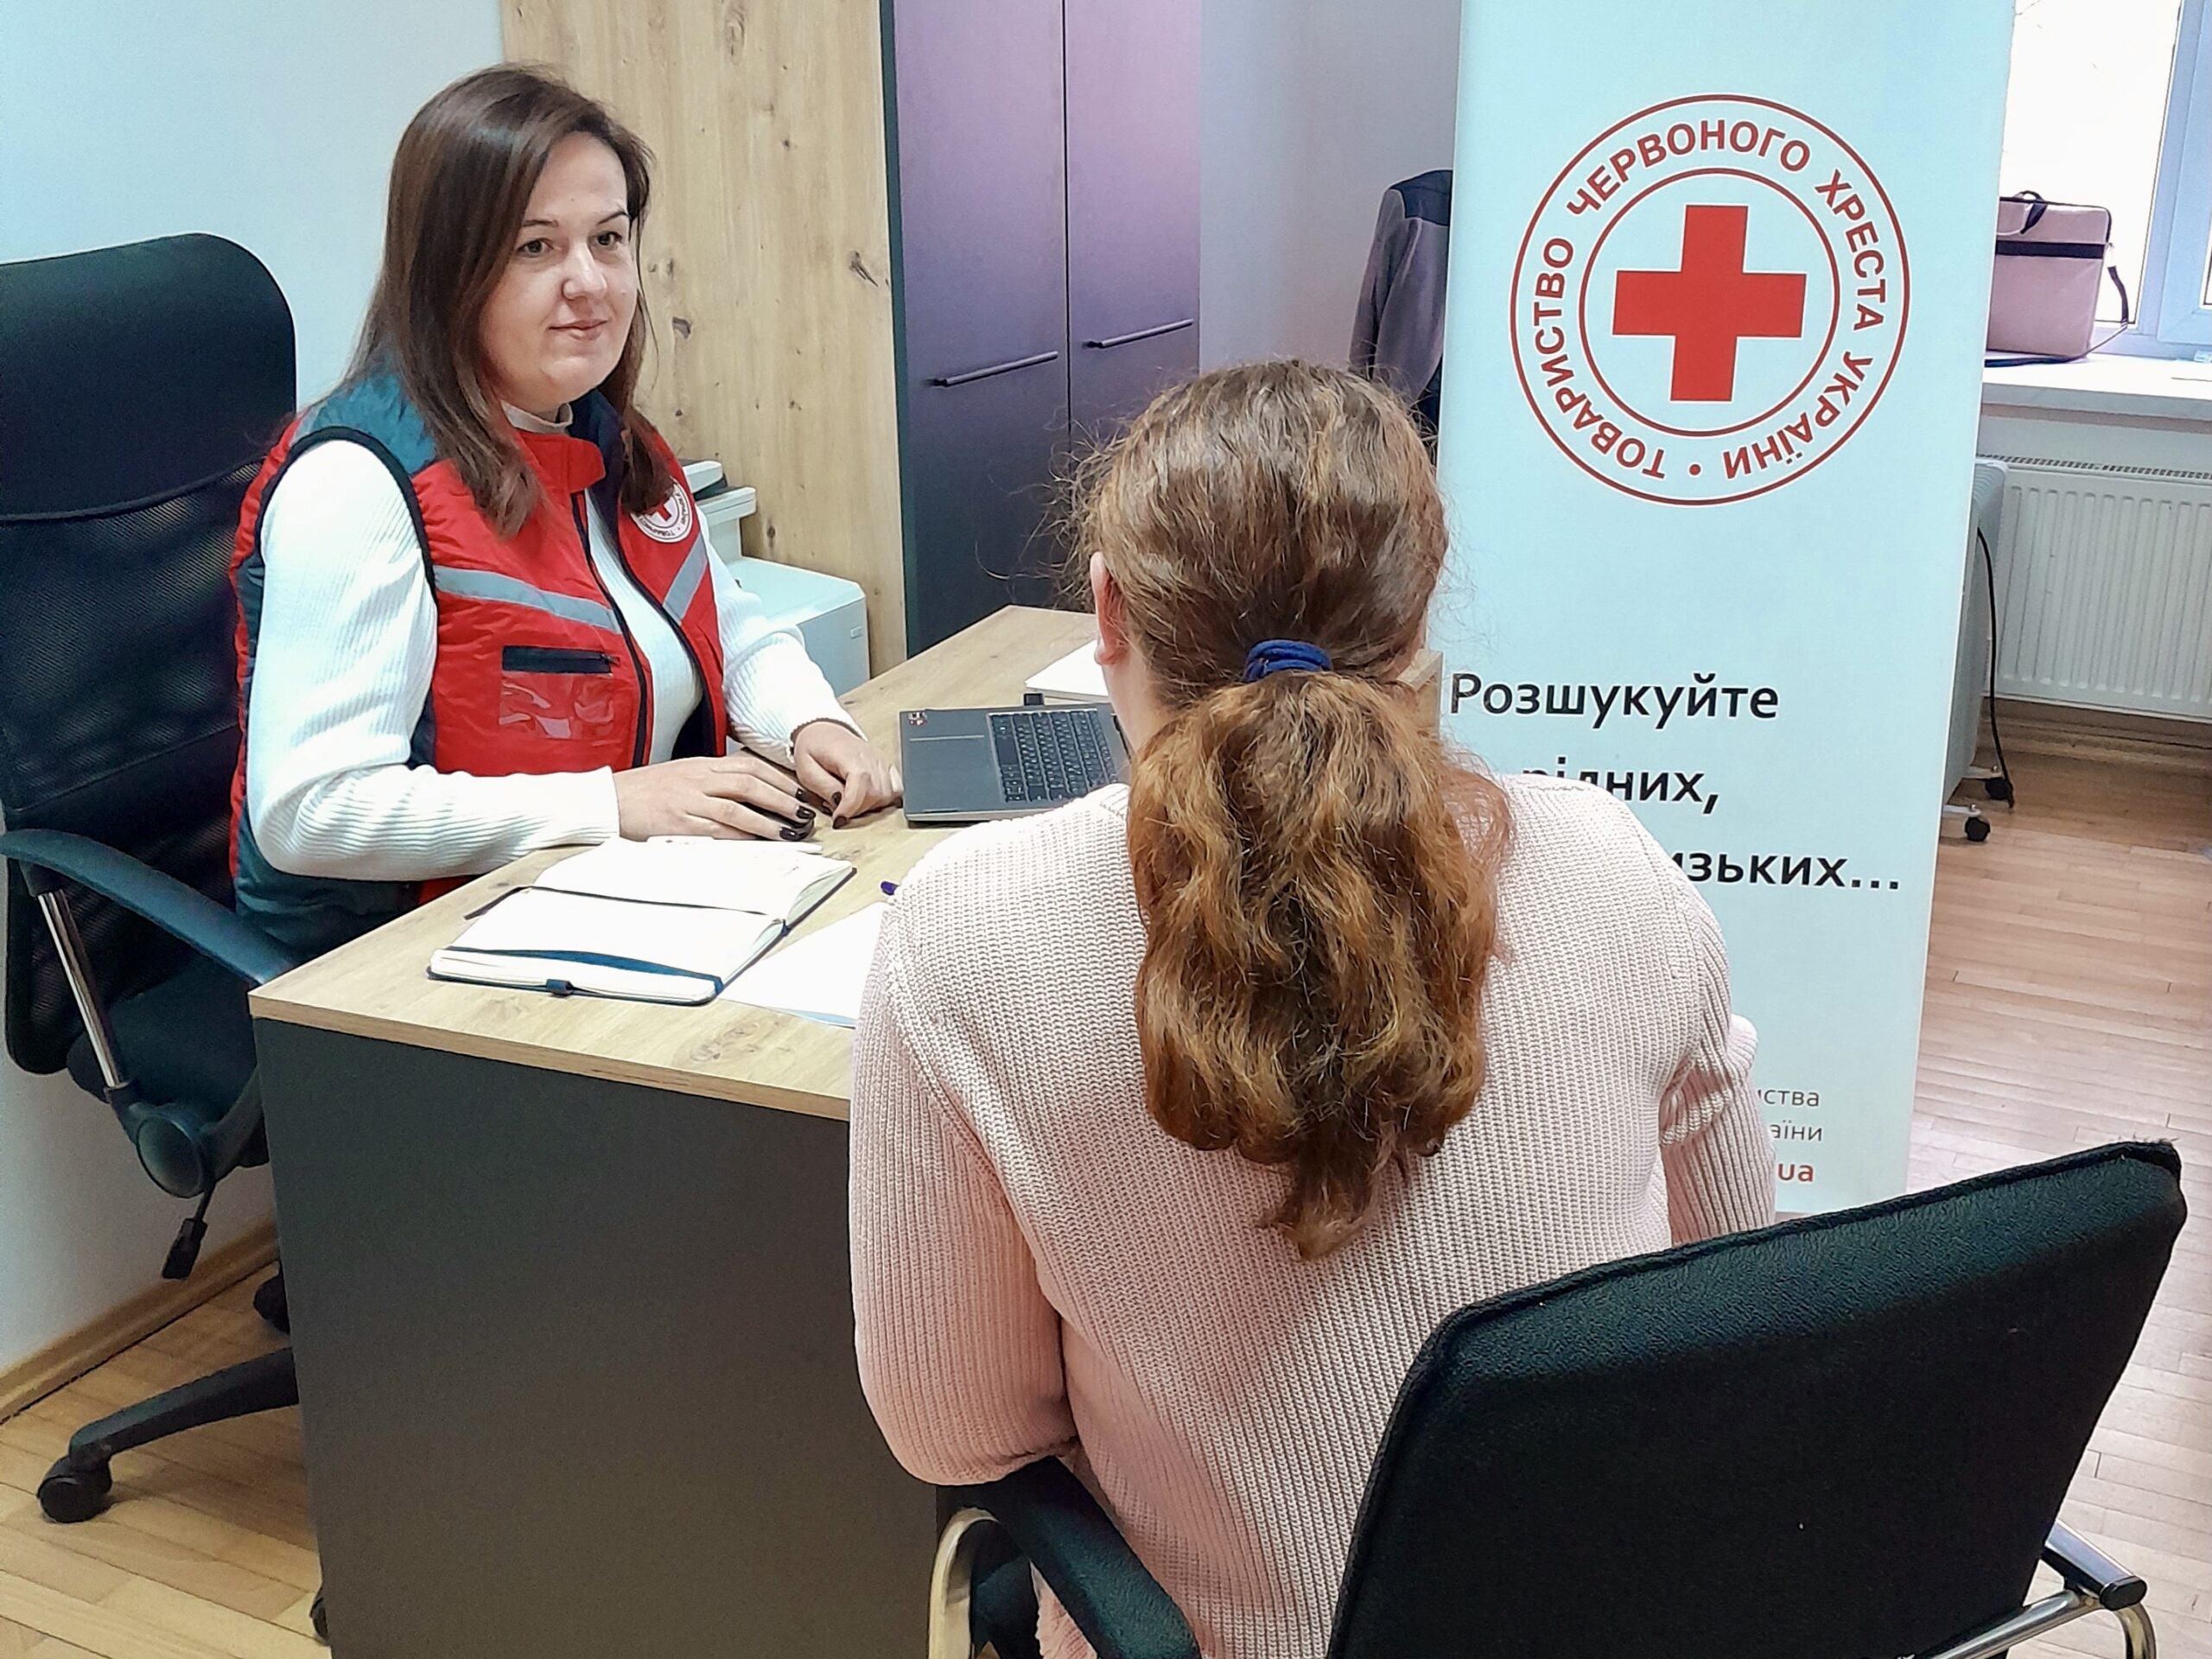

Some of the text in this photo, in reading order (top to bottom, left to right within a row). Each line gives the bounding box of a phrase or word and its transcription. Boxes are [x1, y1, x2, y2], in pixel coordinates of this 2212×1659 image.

[1534, 121, 1885, 479] ТОВАРИСТВО ЧЕРВОНОГО ХРЕСТА УКРАЇНИ
[1451, 672, 1778, 730] Розшукуйте
[1523, 756, 1719, 815] них,
[1758, 1090, 1819, 1106] ства
[1777, 1163, 1814, 1183] ua
